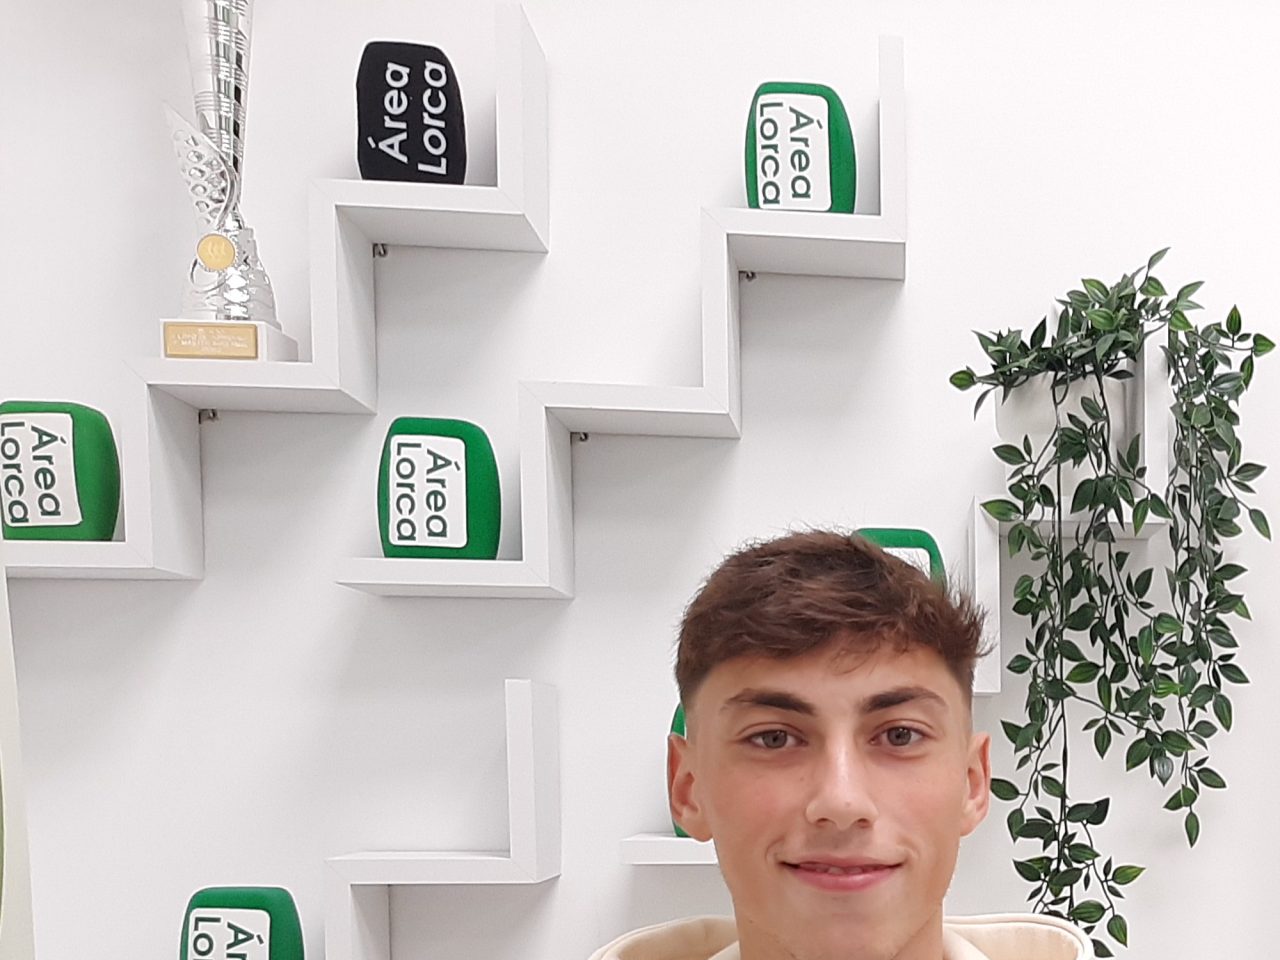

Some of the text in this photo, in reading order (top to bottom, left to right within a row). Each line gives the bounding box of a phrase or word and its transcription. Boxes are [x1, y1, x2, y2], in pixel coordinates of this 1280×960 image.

[367, 62, 410, 164] Área
[417, 60, 448, 175] Lorca
[760, 102, 784, 204] Lorca
[789, 106, 823, 199] Área
[0, 421, 29, 523] Lorca
[31, 425, 67, 516] Área
[396, 442, 422, 541] Lorca
[426, 448, 461, 538] Área
